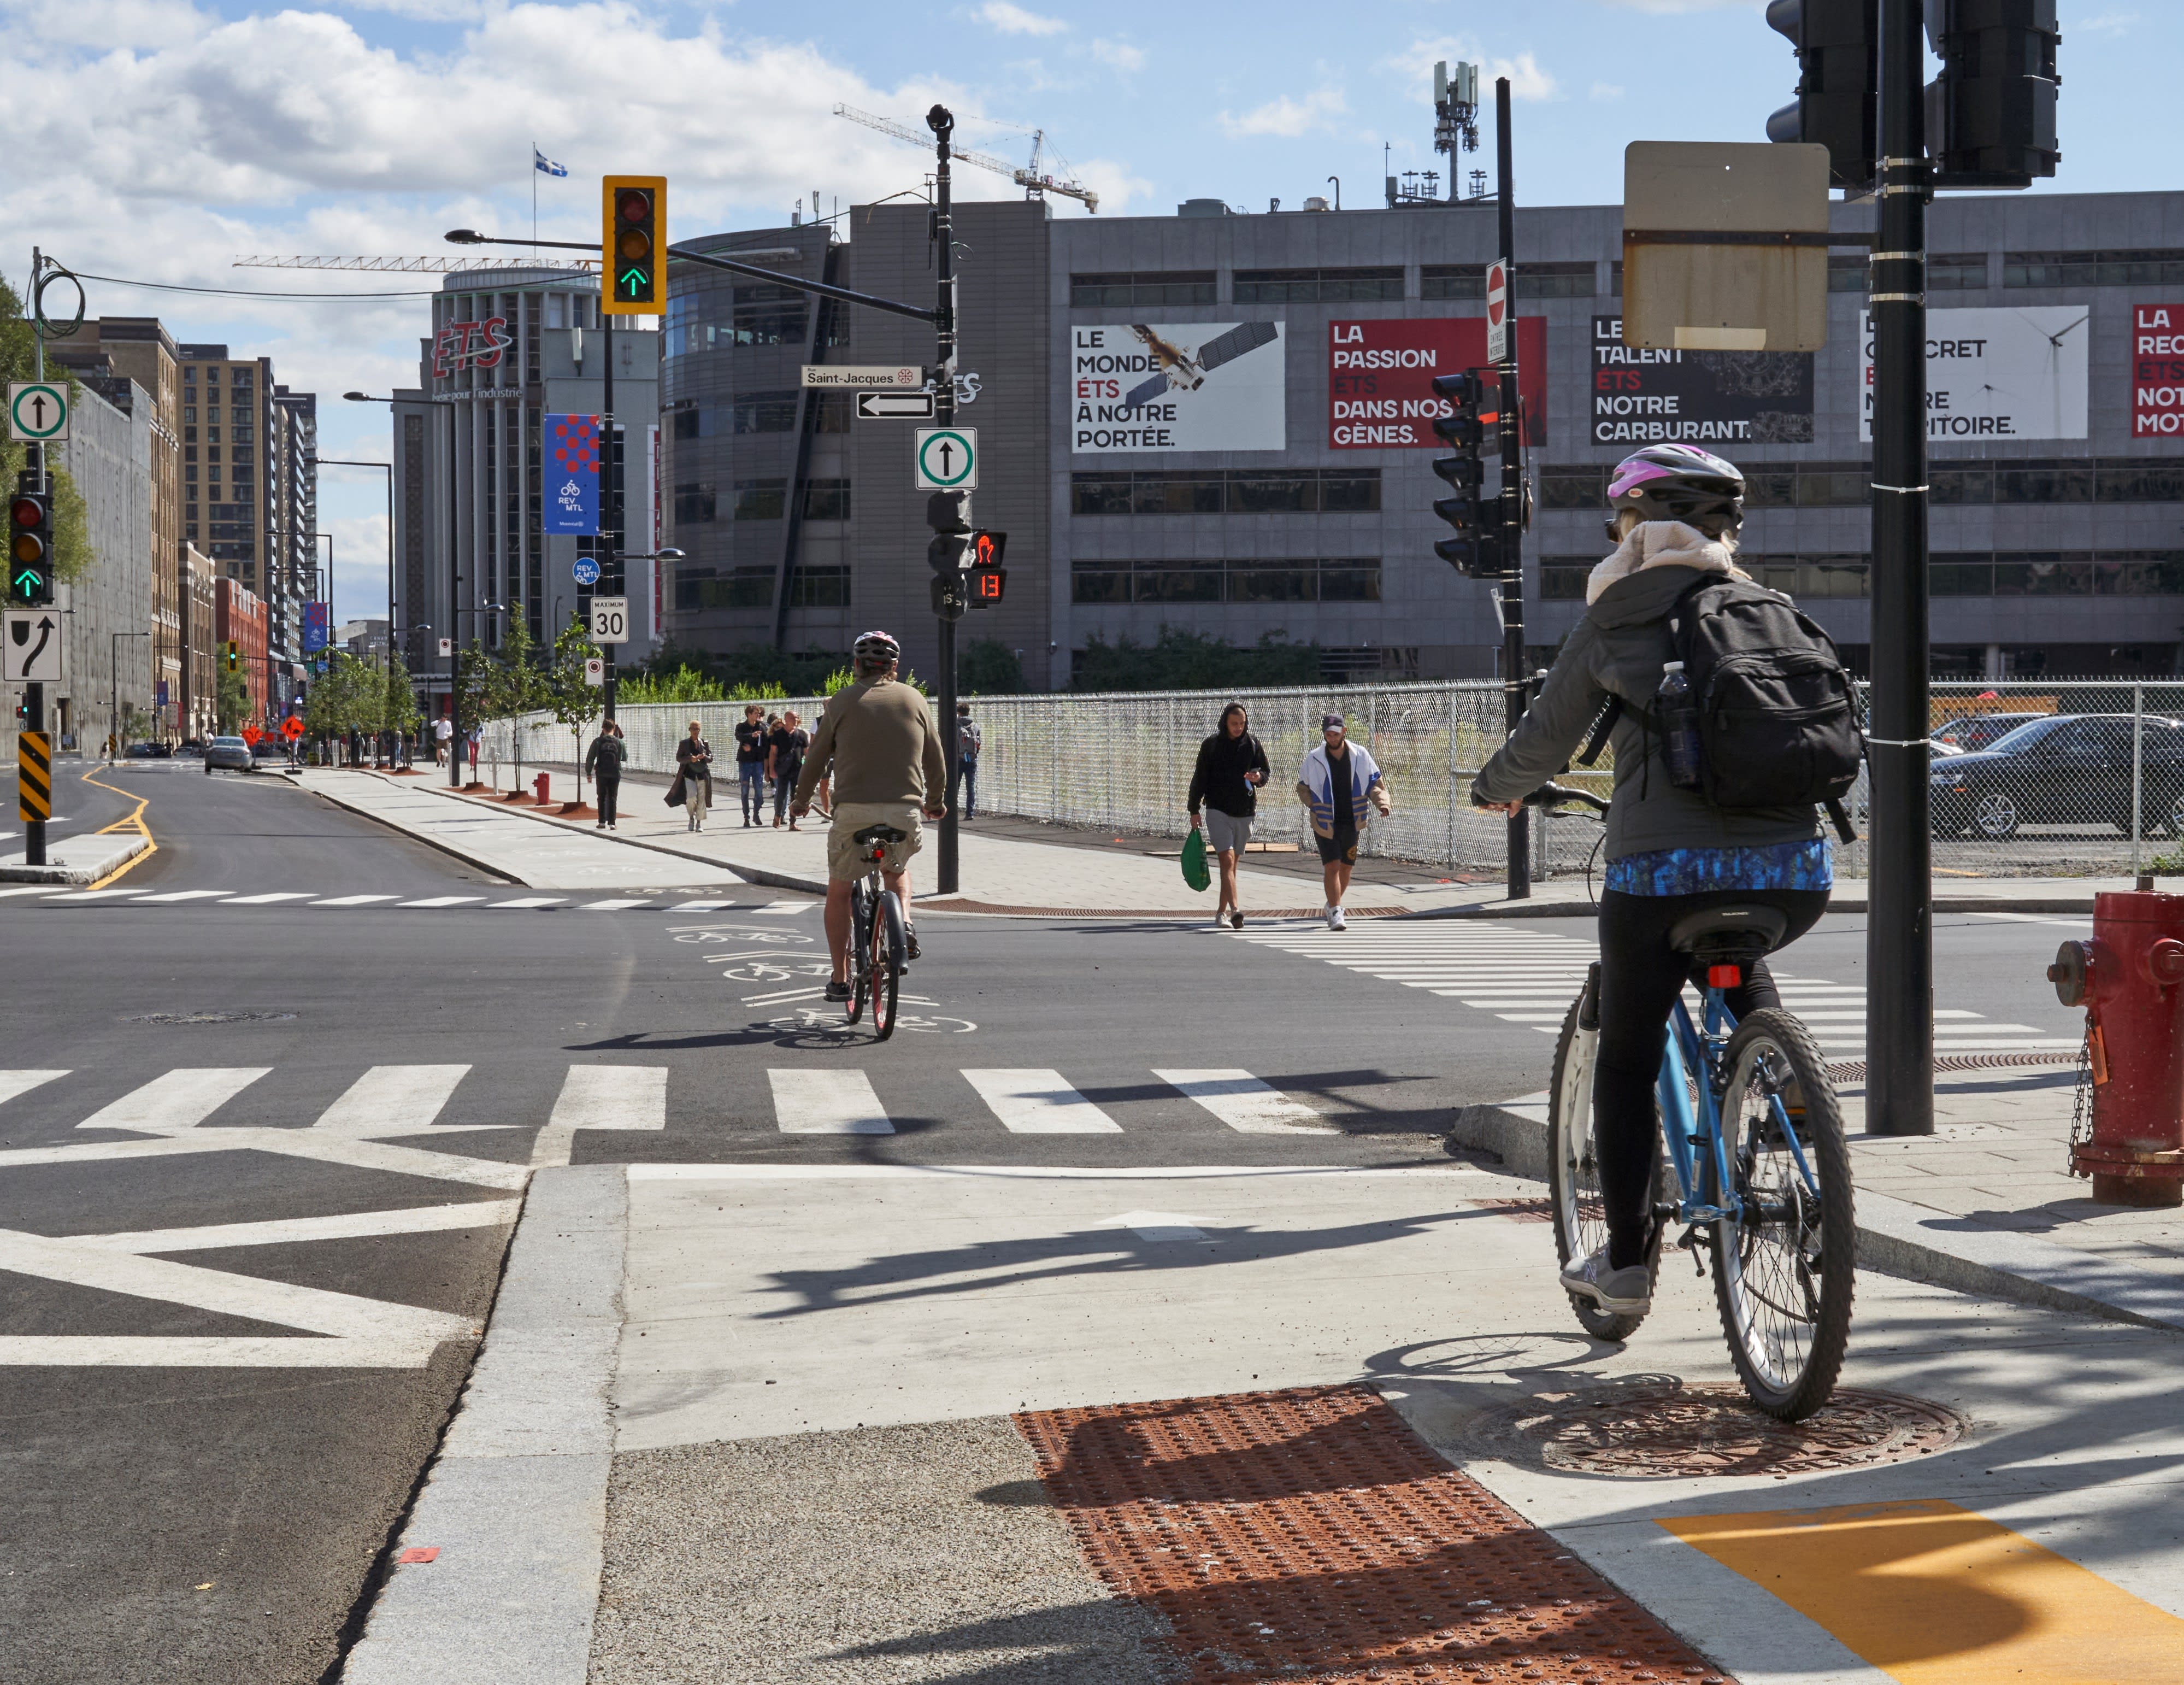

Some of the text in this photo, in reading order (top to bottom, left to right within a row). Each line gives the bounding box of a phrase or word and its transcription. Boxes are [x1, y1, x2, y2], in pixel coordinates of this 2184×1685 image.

[1597, 320, 1622, 338] LE
[2138, 310, 2170, 328] LA
[1077, 331, 1104, 348] LE
[1334, 325, 1364, 343] LA
[432, 317, 507, 378] ÉTS
[1077, 355, 1161, 373] MONDE
[1334, 349, 1436, 368] PASSION
[808, 373, 893, 385] Saint-Jacques
[1596, 367, 1641, 390] ÉTS
[2138, 357, 2184, 381] ÉTS
[451, 391, 472, 402] pour
[1077, 377, 1120, 398] ÉTS
[1077, 402, 1176, 422] À NOTRE
[1334, 399, 1453, 419] DANS NOS
[1597, 396, 1679, 415] NOTRE
[1078, 425, 1175, 448] PORTÉE.
[1334, 422, 1418, 444] GÈNES.
[1596, 420, 1751, 441] CARBURANT.
[982, 575, 999, 596] 13
[596, 613, 623, 635] 30
